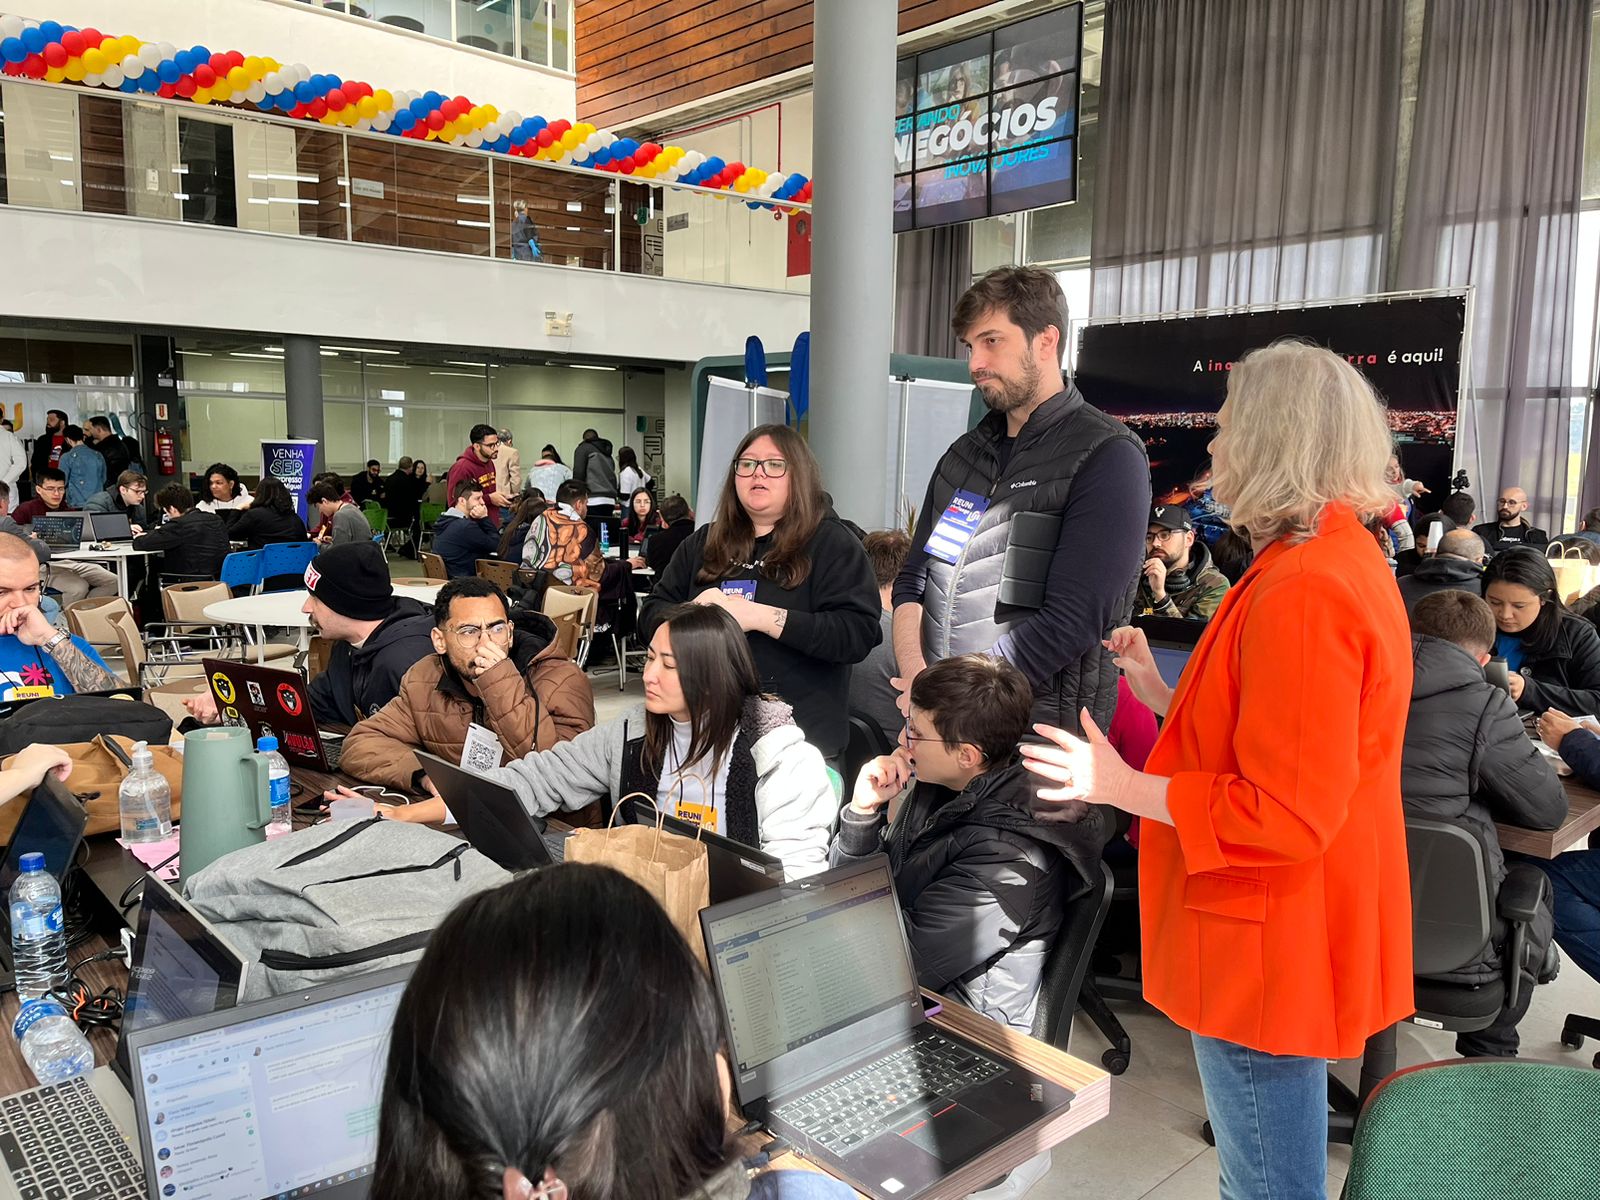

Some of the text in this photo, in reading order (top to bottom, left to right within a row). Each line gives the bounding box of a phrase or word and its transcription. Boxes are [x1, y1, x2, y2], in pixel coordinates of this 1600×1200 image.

[894, 97, 1059, 163] NEGÓCIOS
[943, 135, 1054, 180] INOVADORES
[1193, 360, 1203, 372] A
[1347, 354, 1377, 365] rra
[1388, 350, 1397, 364] é
[1402, 348, 1444, 366] aqui!
[272, 448, 304, 459] VENHA
[270, 459, 304, 477] SER
[952, 496, 975, 510] REUNI
[677, 809, 702, 821] REUNI
